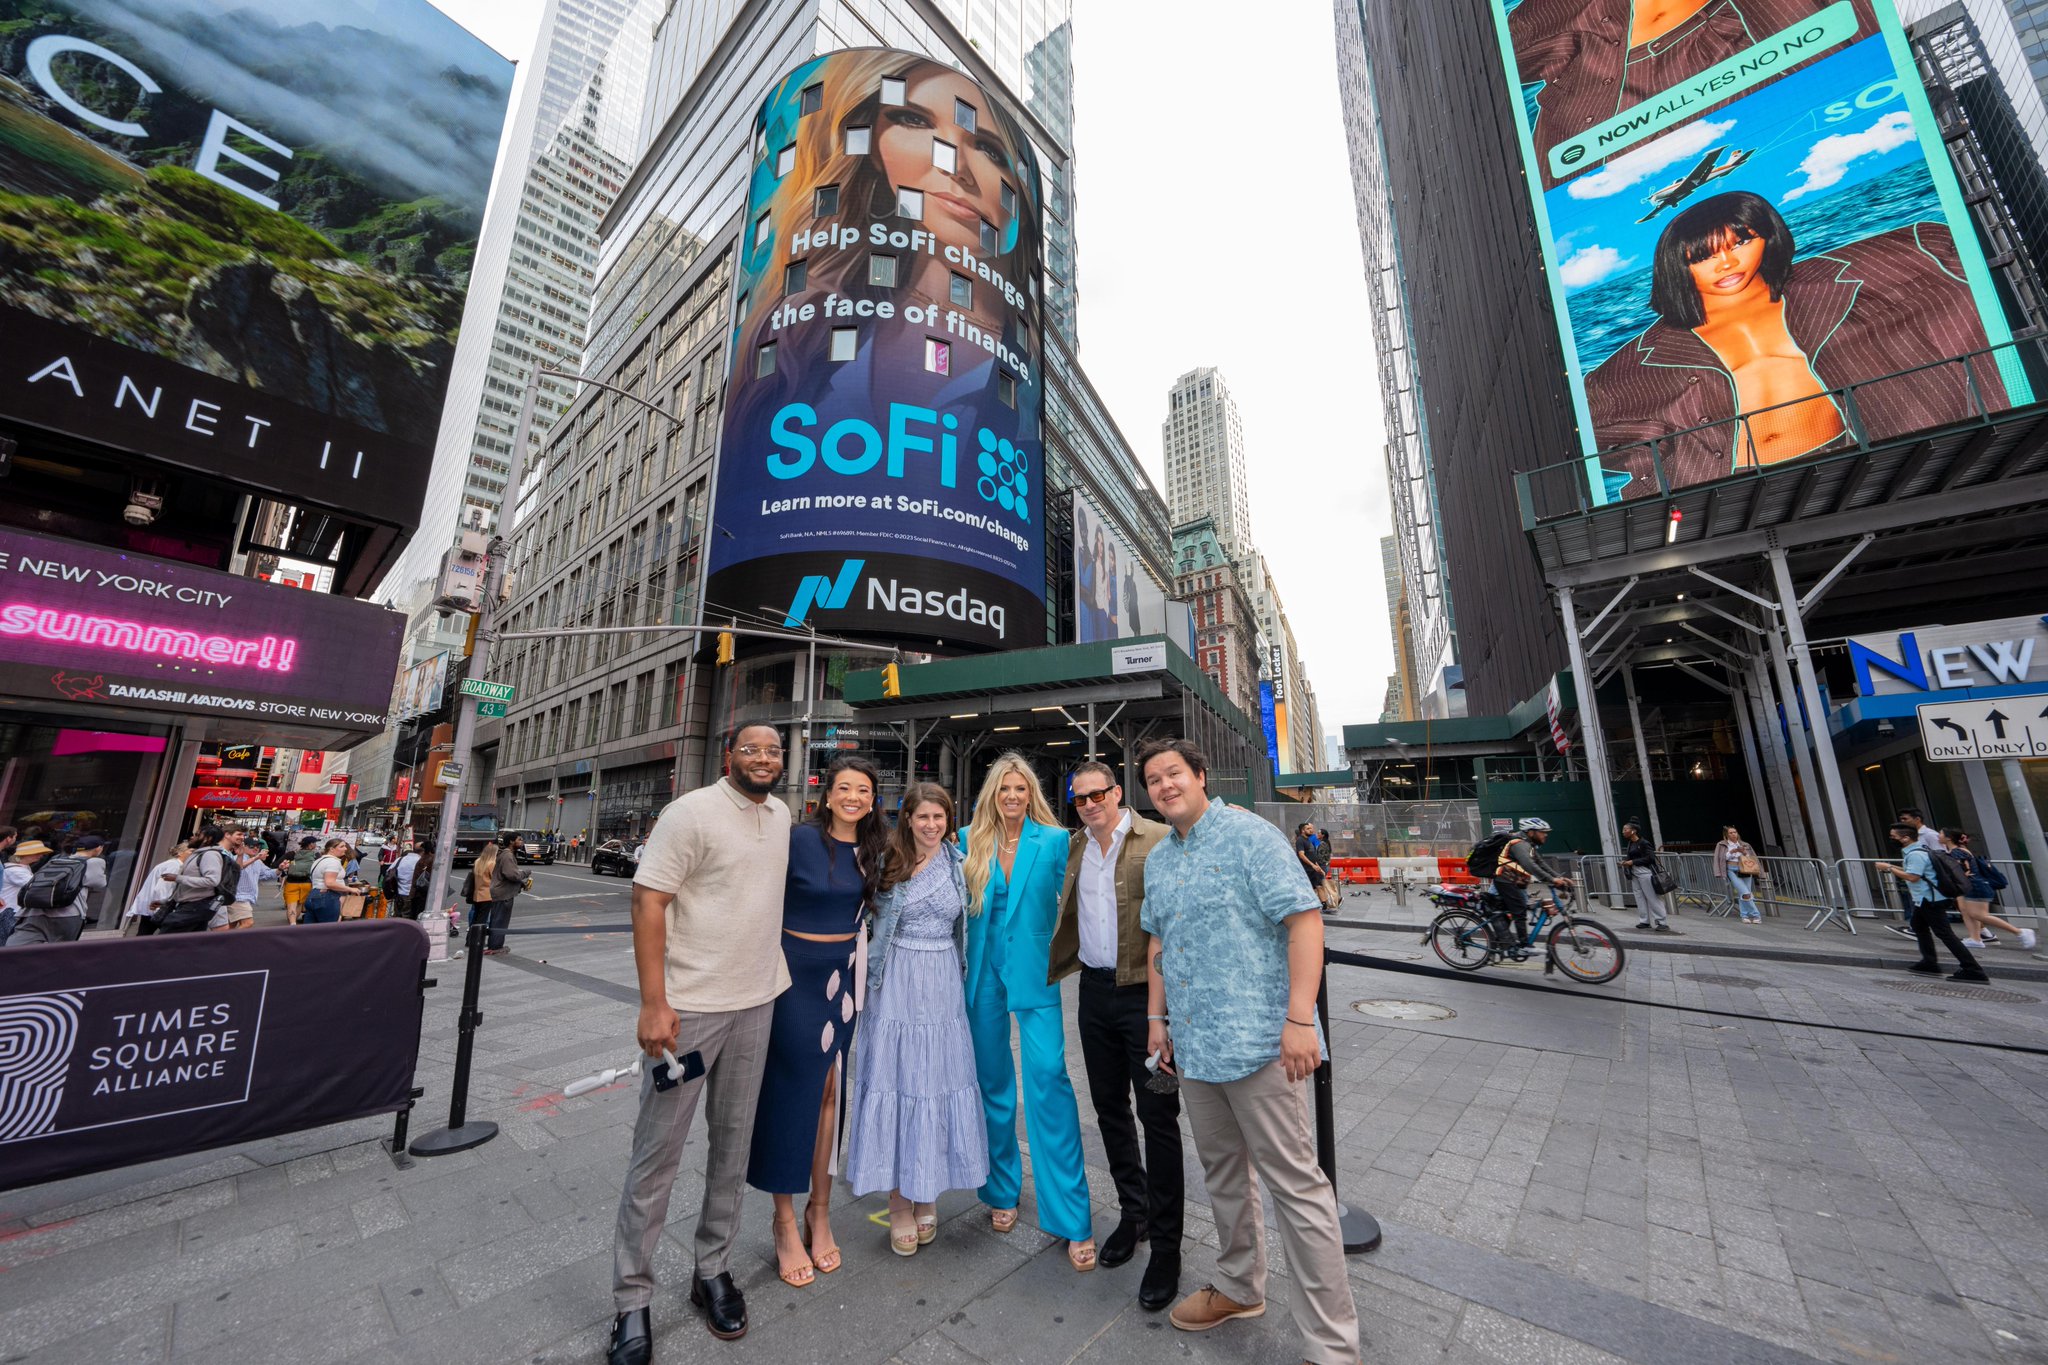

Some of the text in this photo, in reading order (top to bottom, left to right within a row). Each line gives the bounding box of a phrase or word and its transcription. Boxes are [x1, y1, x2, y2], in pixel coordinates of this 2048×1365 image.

[1597, 26, 1825, 146] NOW ALL YES NO NO
[791, 223, 1025, 311] Help SoFi change
[771, 303, 815, 331] the
[824, 293, 895, 319] face
[904, 304, 938, 327] of
[946, 311, 1032, 387] finance.
[27, 355, 363, 479] ANET II
[766, 402, 958, 489] SoFi
[761, 495, 1029, 552] Learn more at SoFi.com/change
[18, 556, 91, 582] NEW
[96, 570, 173, 599] YORK
[176, 587, 233, 608] CITY
[867, 577, 1006, 639] Nasdaq
[0, 604, 295, 671] summer!!
[1125, 656, 1153, 665] Turner
[1272, 648, 1283, 699] Foot Locker
[109, 684, 185, 703] TAMASHII
[259, 702, 306, 717] STORE
[310, 707, 342, 721] NEW
[344, 710, 382, 725] YORK
[460, 680, 511, 699] BROADWAY
[481, 703, 495, 715] 43
[836, 729, 859, 737] Nasdaq
[1933, 745, 1973, 757] ONLY
[1982, 742, 2025, 755] ONLY
[228, 748, 251, 760] Cafe
[254, 794, 305, 804] DINER
[113, 1003, 230, 1038] TIMES
[89, 1029, 240, 1070] SQUARE
[92, 1060, 226, 1096] ALLIANCE
